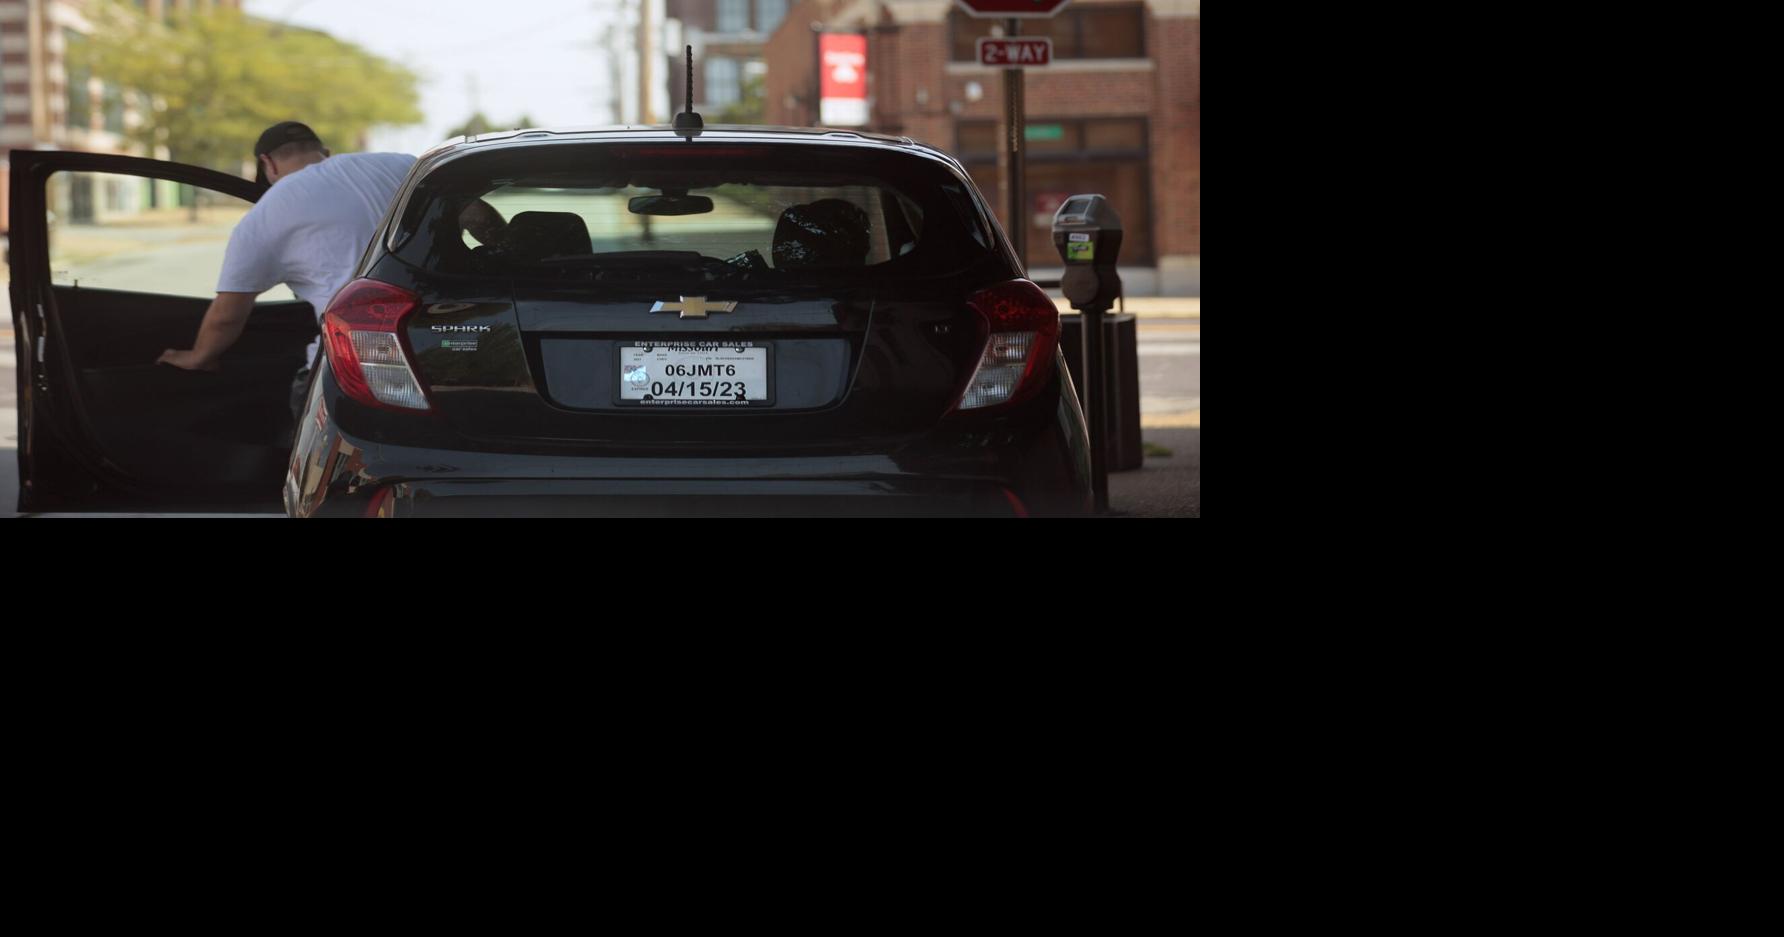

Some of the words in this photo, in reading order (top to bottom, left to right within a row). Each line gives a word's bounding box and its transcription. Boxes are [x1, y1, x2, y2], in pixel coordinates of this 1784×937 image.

[983, 43, 1045, 62] 2-WAY
[431, 325, 491, 333] SPARK
[665, 364, 736, 376] 06JMT6
[651, 381, 746, 397] 04/15/23
